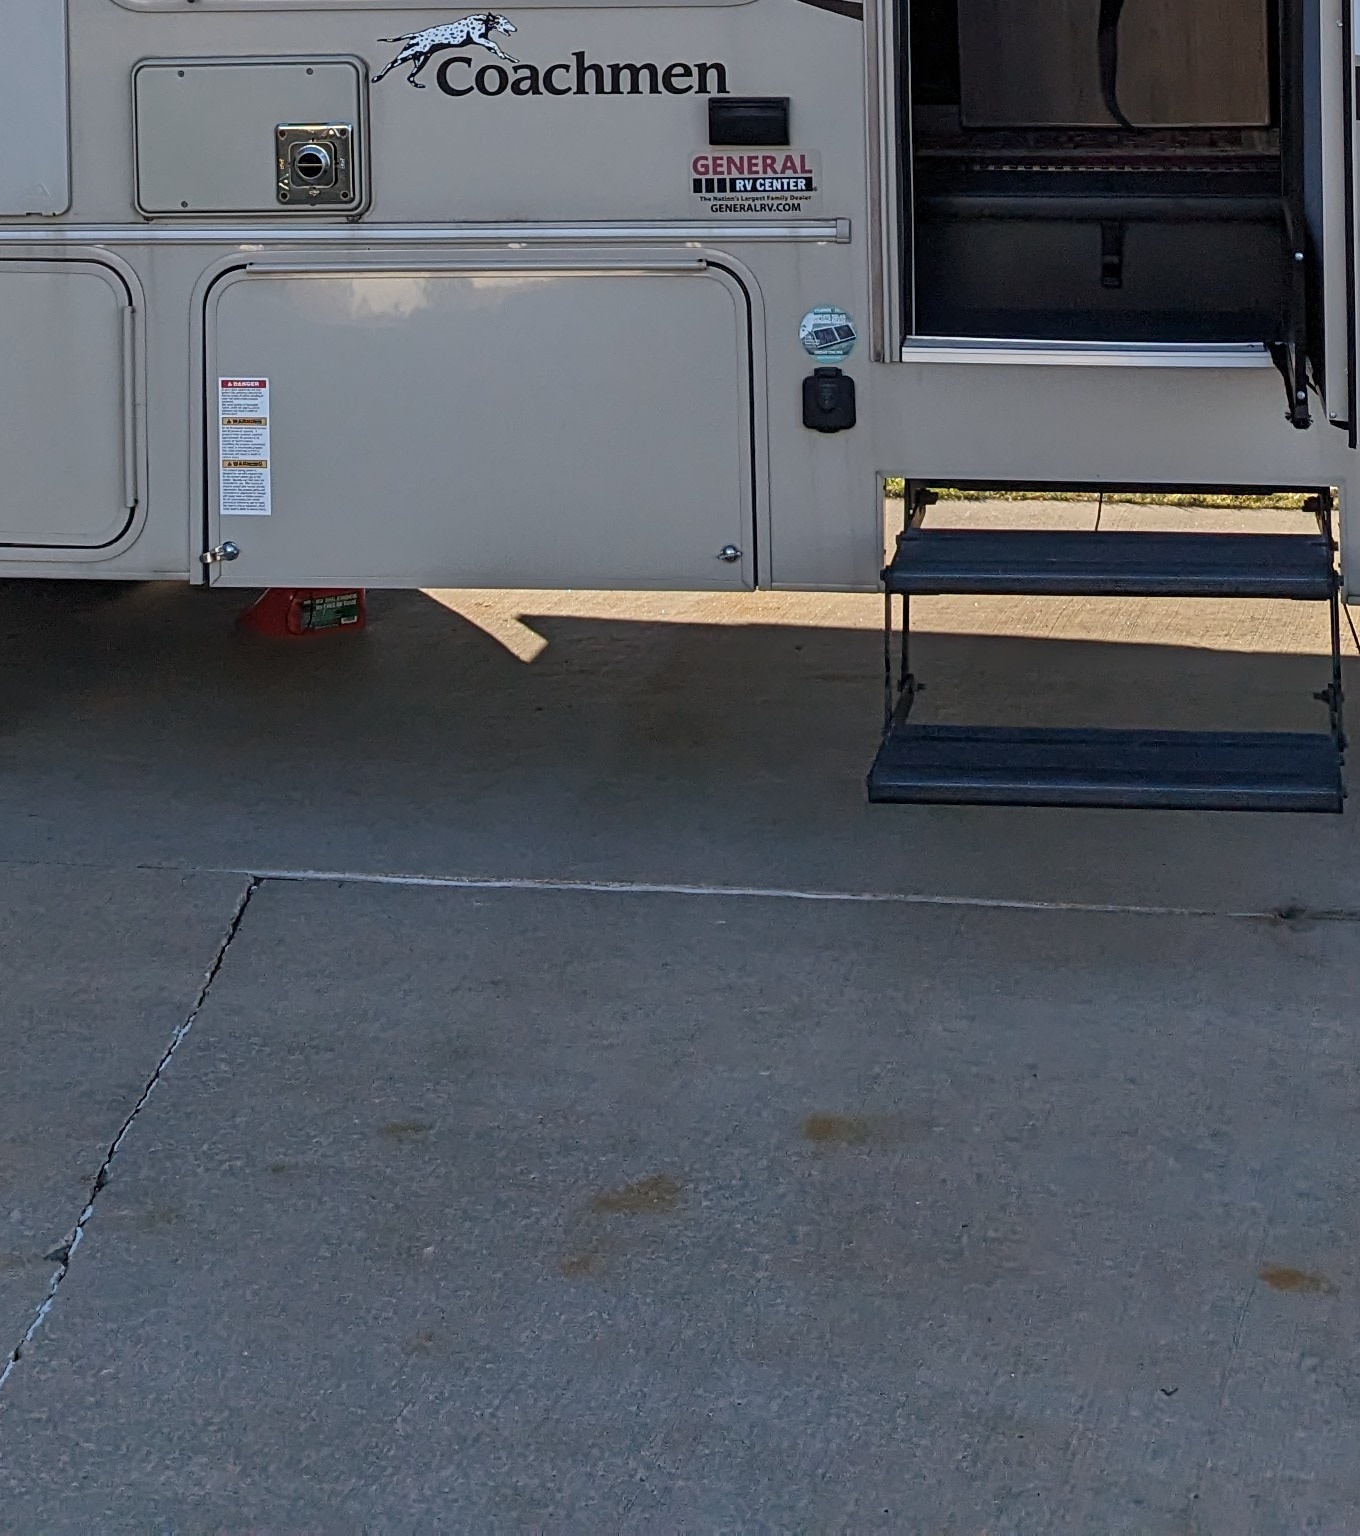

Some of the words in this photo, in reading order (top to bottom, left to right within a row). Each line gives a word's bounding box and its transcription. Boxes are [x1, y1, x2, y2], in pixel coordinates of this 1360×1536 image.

[437, 51, 730, 97] Coachmen
[692, 154, 813, 176] GENERAL
[735, 179, 753, 191] RV
[756, 178, 806, 191] CENTER
[710, 203, 801, 213] GENERALRV.COM
